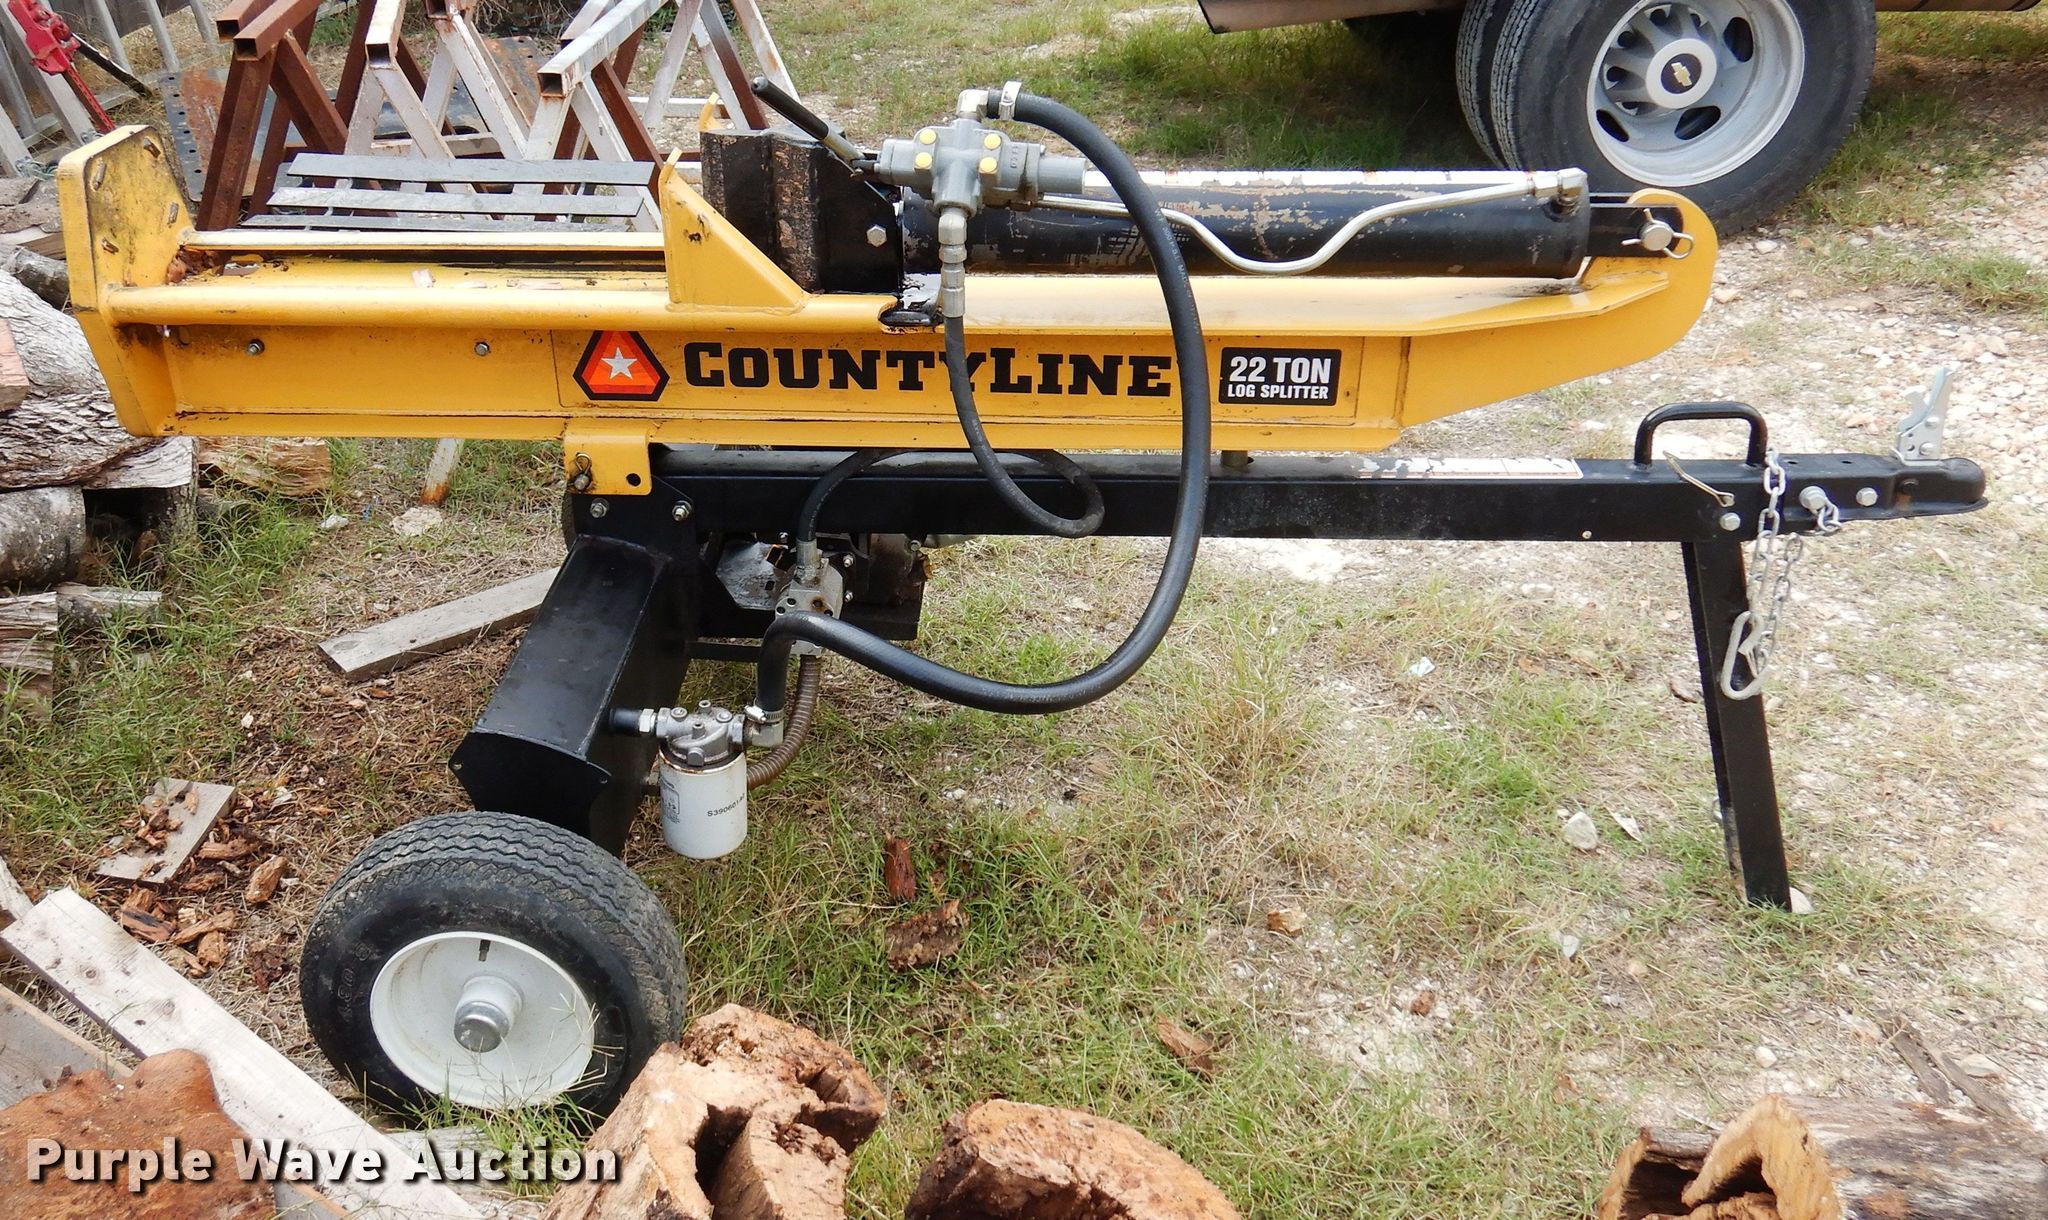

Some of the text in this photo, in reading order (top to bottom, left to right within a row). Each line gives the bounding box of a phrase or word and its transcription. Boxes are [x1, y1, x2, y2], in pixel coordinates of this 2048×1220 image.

[1229, 356, 1331, 384] 22 TON
[1227, 384, 1328, 400] LOG SPLITTER
